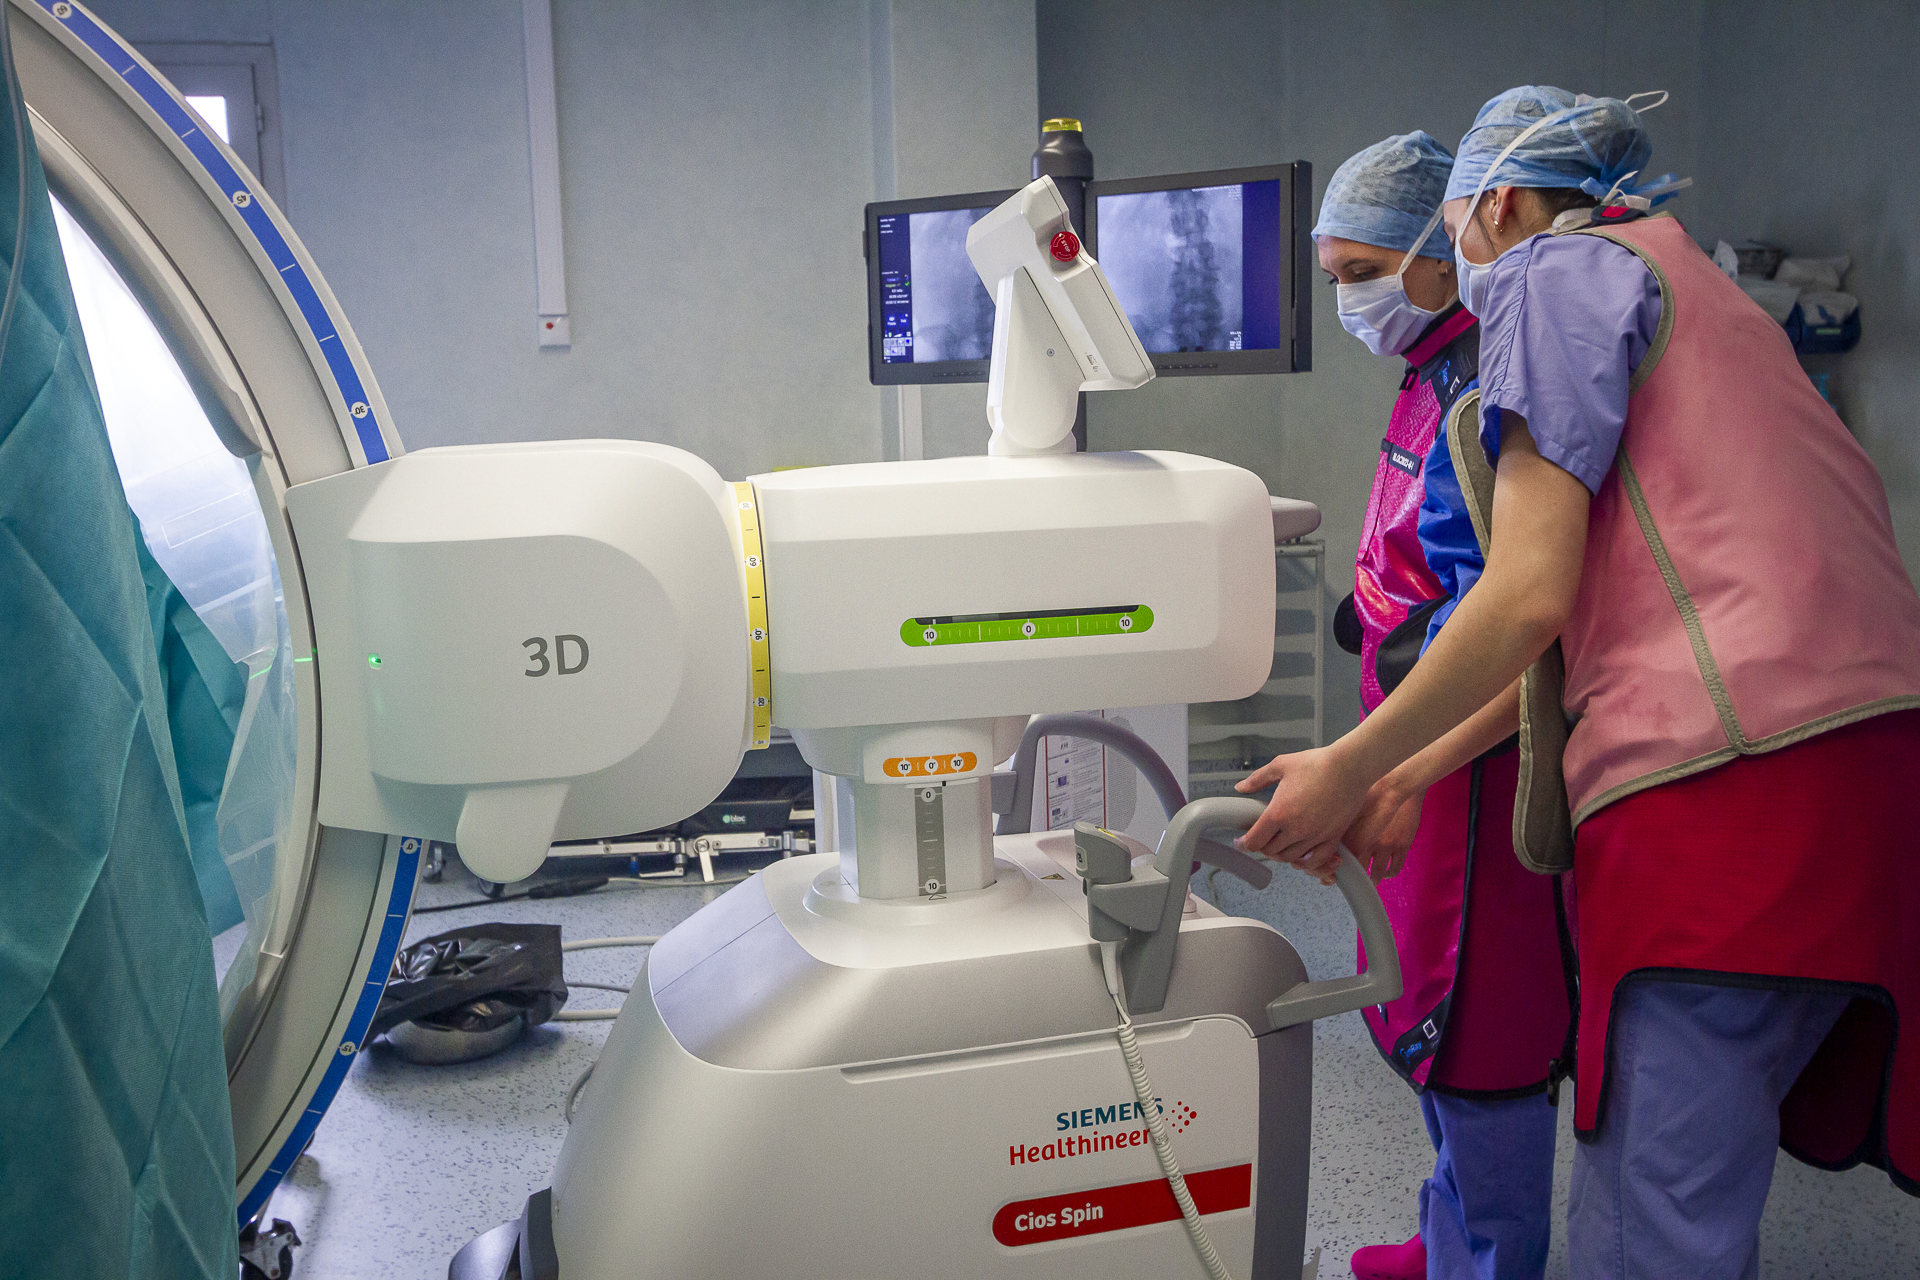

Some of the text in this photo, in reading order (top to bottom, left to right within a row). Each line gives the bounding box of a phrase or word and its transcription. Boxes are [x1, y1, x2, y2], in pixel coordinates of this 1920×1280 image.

[925, 618, 1131, 640] 10 0 10
[521, 634, 590, 677] 3D
[925, 791, 932, 799] 0
[928, 882, 938, 890] 10
[1009, 1130, 1152, 1166] Healthineer
[1014, 1202, 1104, 1232] Cios Spin
